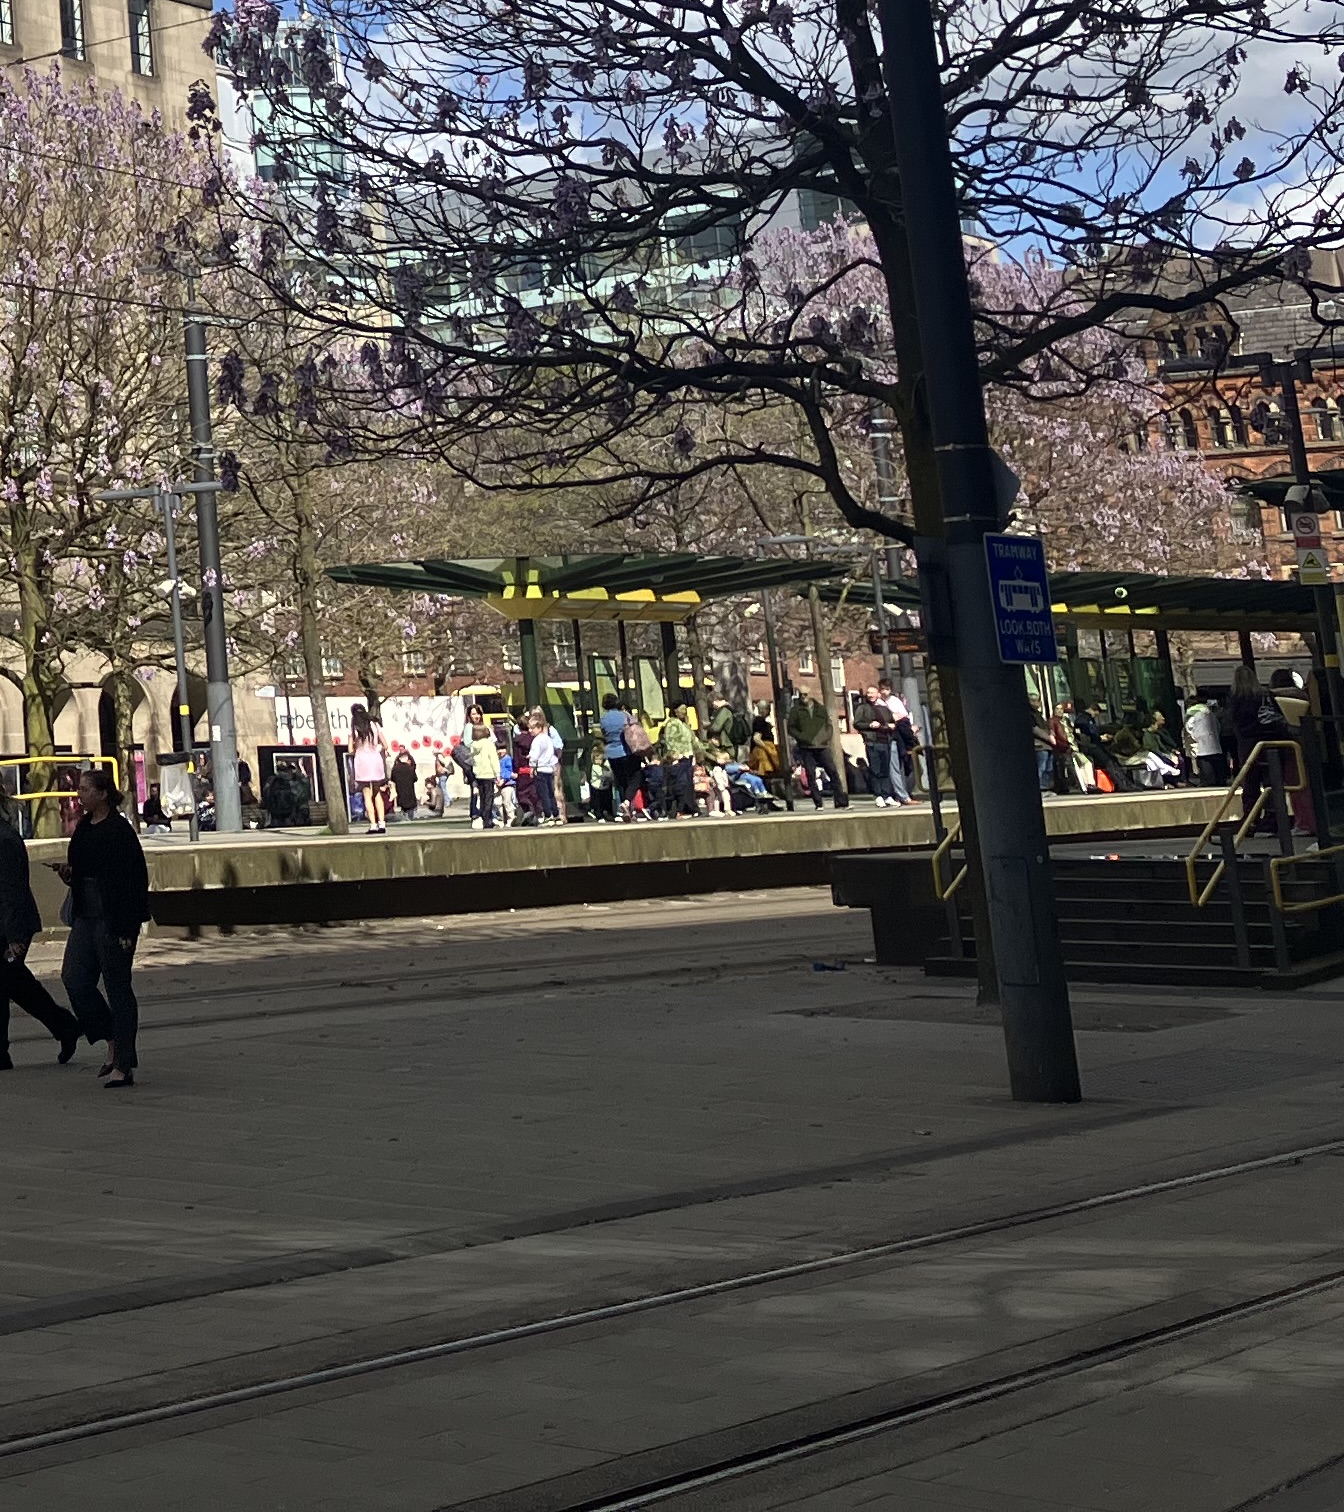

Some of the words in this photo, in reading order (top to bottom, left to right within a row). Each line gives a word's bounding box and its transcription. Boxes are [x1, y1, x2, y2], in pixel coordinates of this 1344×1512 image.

[992, 543, 1037, 561] TRAMWAY
[1000, 619, 1025, 635] LOOK
[1026, 620, 1051, 636] BOTH
[1015, 638, 1041, 655] WAYS
